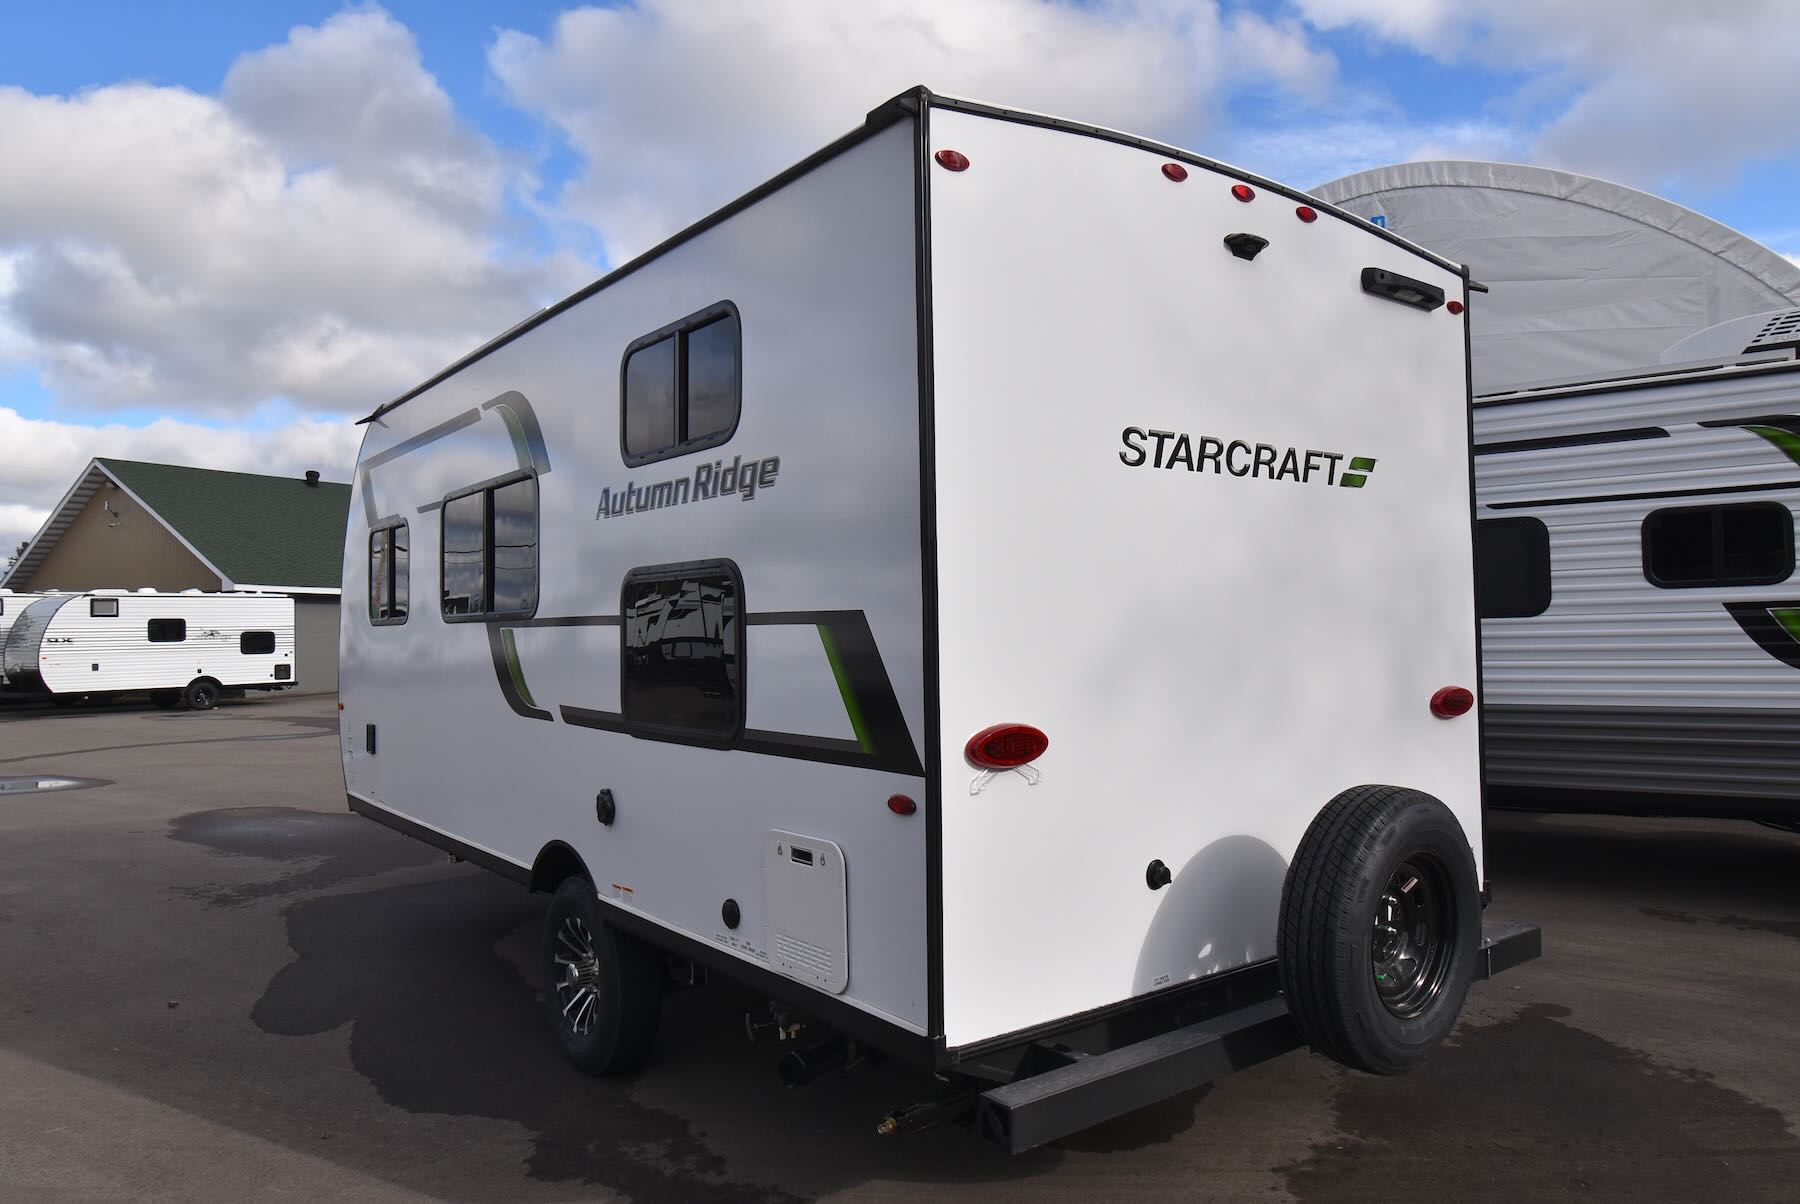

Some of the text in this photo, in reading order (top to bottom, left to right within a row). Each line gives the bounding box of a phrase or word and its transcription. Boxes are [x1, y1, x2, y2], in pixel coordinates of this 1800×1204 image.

[595, 454, 781, 520] Autumn Ridge
[1119, 426, 1344, 486] STARCRAFT
